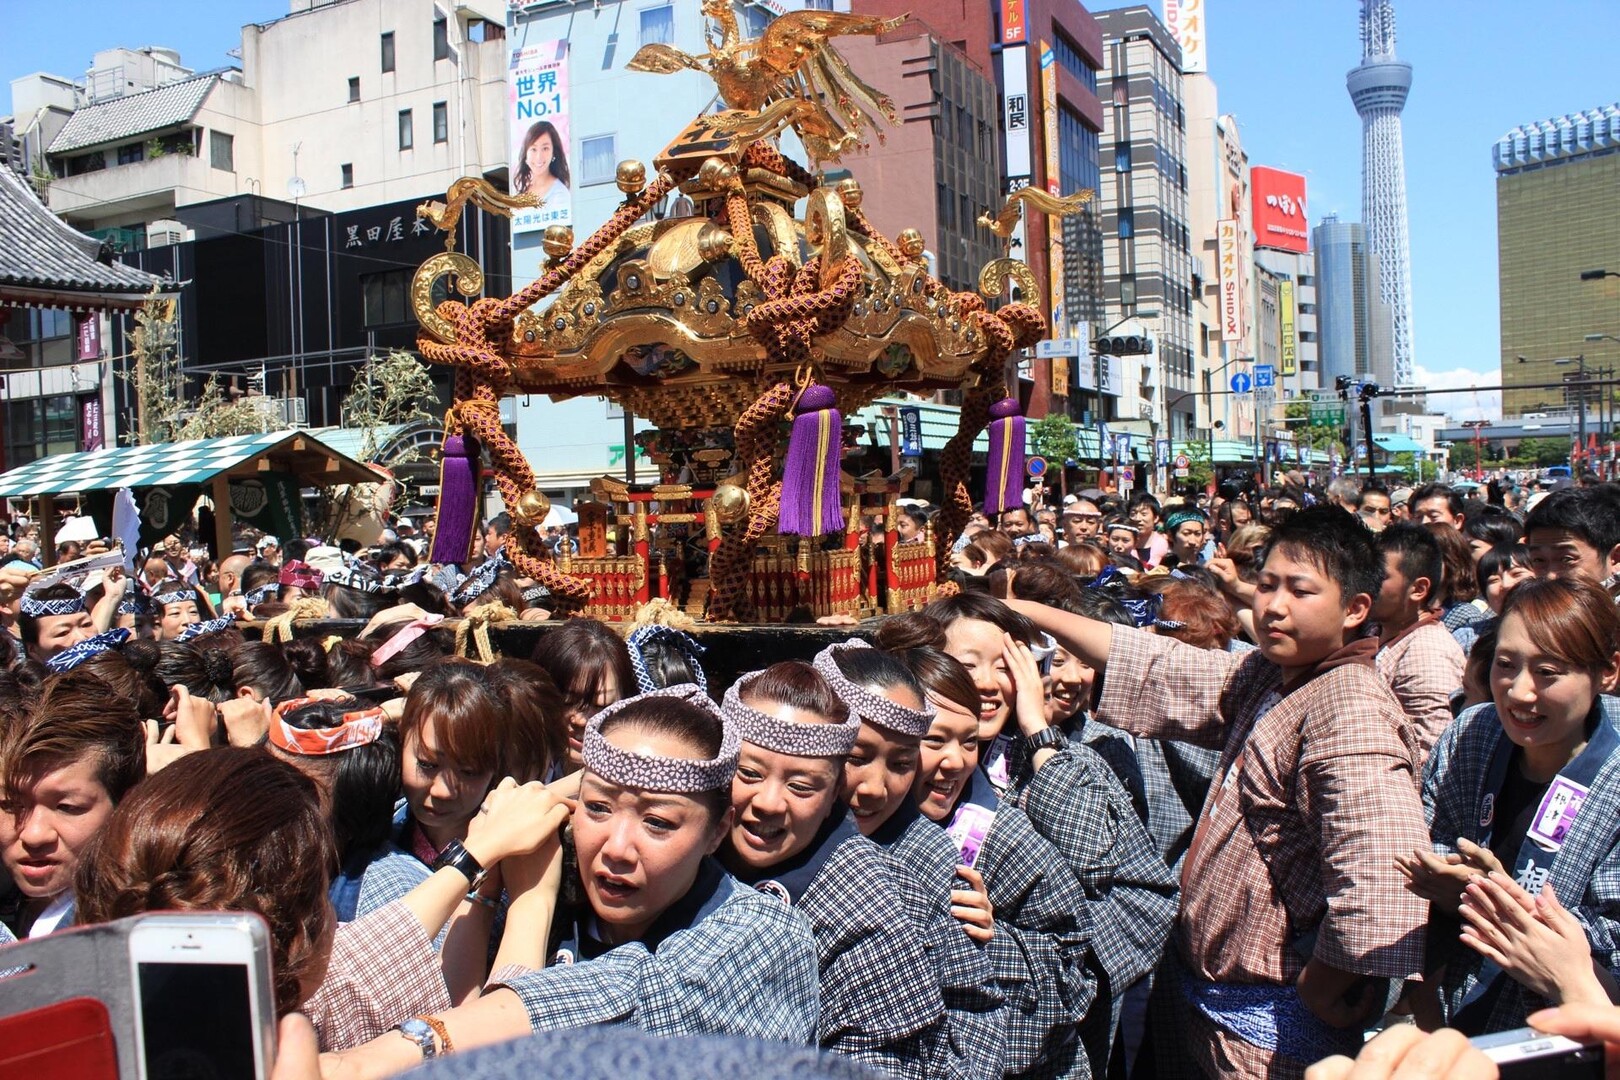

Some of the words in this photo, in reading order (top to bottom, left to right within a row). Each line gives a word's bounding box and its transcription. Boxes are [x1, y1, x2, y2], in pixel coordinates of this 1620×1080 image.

[1006, 27, 1021, 39] 5F
[516, 71, 557, 98] 世界
[517, 93, 561, 120] No.1
[1009, 97, 1024, 128] 和民
[515, 208, 569, 226] 太陽光は東芝
[345, 216, 440, 249] 黒田屋本
[1222, 226, 1234, 279] カラオケ
[1226, 281, 1237, 334] SHIDAX
